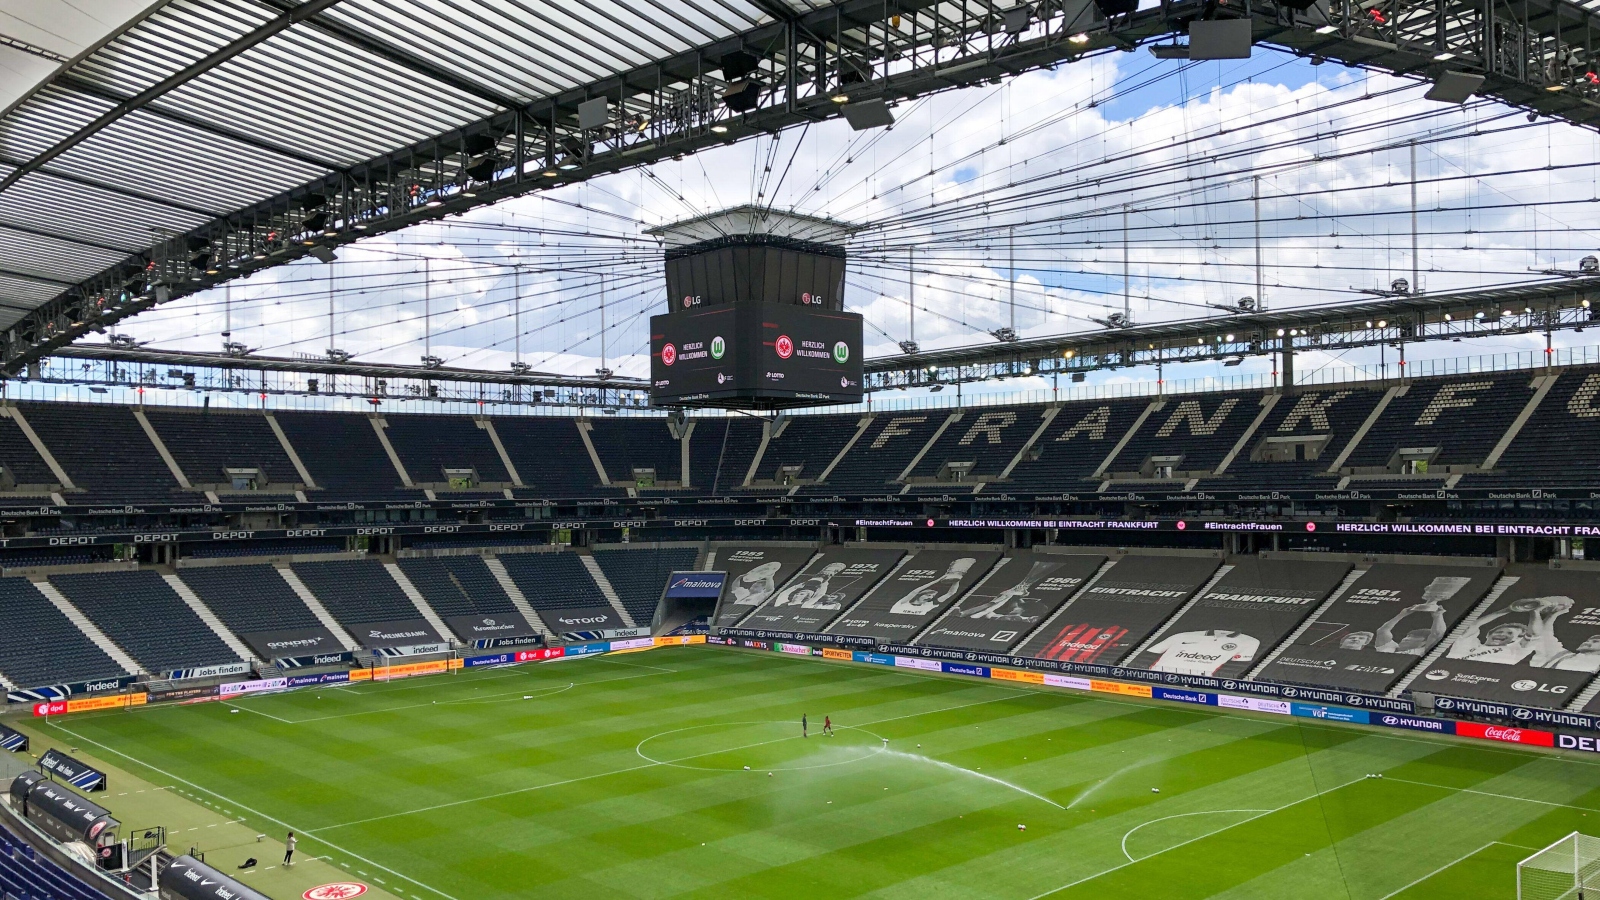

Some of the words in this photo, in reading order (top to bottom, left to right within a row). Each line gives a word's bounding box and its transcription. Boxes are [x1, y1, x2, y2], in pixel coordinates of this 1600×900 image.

[692, 296, 701, 305] LG
[811, 296, 822, 305] LG
[683, 342, 703, 351] HERZLICH
[802, 341, 825, 349] HERZLICH
[679, 350, 708, 360] WILLKOMMEN
[797, 349, 830, 359] WILLKOMMEN
[424, 525, 461, 533] DEPOT
[489, 523, 525, 531] DEPOT
[1107, 521, 1158, 529] FRANKFURT
[1204, 522, 1282, 530] #EintrachtFrauen
[1337, 523, 1388, 532] HERZLICH
[1391, 524, 1472, 533] WILLKOMMEN
[1475, 525, 1494, 533] BEI
[1498, 525, 1570, 535] EINTRACHT
[213, 531, 254, 540] DEPOT
[286, 529, 327, 537] DEPOT
[356, 527, 395, 535] DEPOT
[49, 536, 97, 545] DEPOT
[134, 534, 179, 542] DEPOT
[683, 579, 722, 590] mainova
[1088, 587, 1187, 598] EINTRACHT
[1357, 588, 1401, 597] 1981
[1203, 592, 1316, 605] FRANKFURT
[873, 621, 918, 630] kaspersky
[381, 630, 428, 640] MEINEBANK
[615, 629, 638, 637] indeed
[729, 628, 755, 637] HYUNDAI
[767, 631, 793, 639] HYUNDAI
[943, 629, 986, 639] mainova
[498, 638, 514, 646] Jobs
[515, 636, 536, 645] finden
[806, 634, 833, 642] HYUNDAI
[846, 637, 874, 645] HYUNDAI
[413, 645, 439, 654] indeed
[744, 640, 767, 649] MAXXYS
[1059, 638, 1100, 651] indeed
[824, 649, 851, 659] SPORTWETTEN
[890, 646, 919, 655] HYUNDAI
[933, 650, 963, 659] HYUNDAI
[314, 654, 341, 664] indeed
[978, 654, 1010, 663] HYUNDAI
[1175, 650, 1221, 662] indeed
[1279, 656, 1324, 665] DEUTSCHE
[1025, 659, 1058, 669] HYUNDAI
[1074, 664, 1109, 674] HYUNDAI
[199, 668, 217, 677] Jobs
[219, 666, 243, 674] finden
[1126, 670, 1163, 681] HYUNDAI
[1181, 676, 1219, 687] HYUNDAI
[1456, 672, 1500, 683] SunExpress
[85, 680, 119, 692] indeed
[1239, 683, 1279, 694] HYUNDAI
[1537, 683, 1569, 694] LG
[1163, 692, 1184, 701] Deutsche
[1184, 694, 1197, 702] Bank
[1300, 690, 1343, 702] HYUNDAI
[50, 704, 64, 713] dpd
[1365, 698, 1411, 711] HYUNDAI
[1456, 702, 1508, 716] HYUNDAI
[1400, 716, 1442, 730] HYUNDAI
[1535, 711, 1591, 728] HYUNDAI
[1485, 726, 1521, 741] Coca-Cola
[1559, 734, 1600, 752] DE
[41, 753, 59, 769] indeed
[183, 867, 203, 882] indeed
[215, 885, 235, 900] indeed
